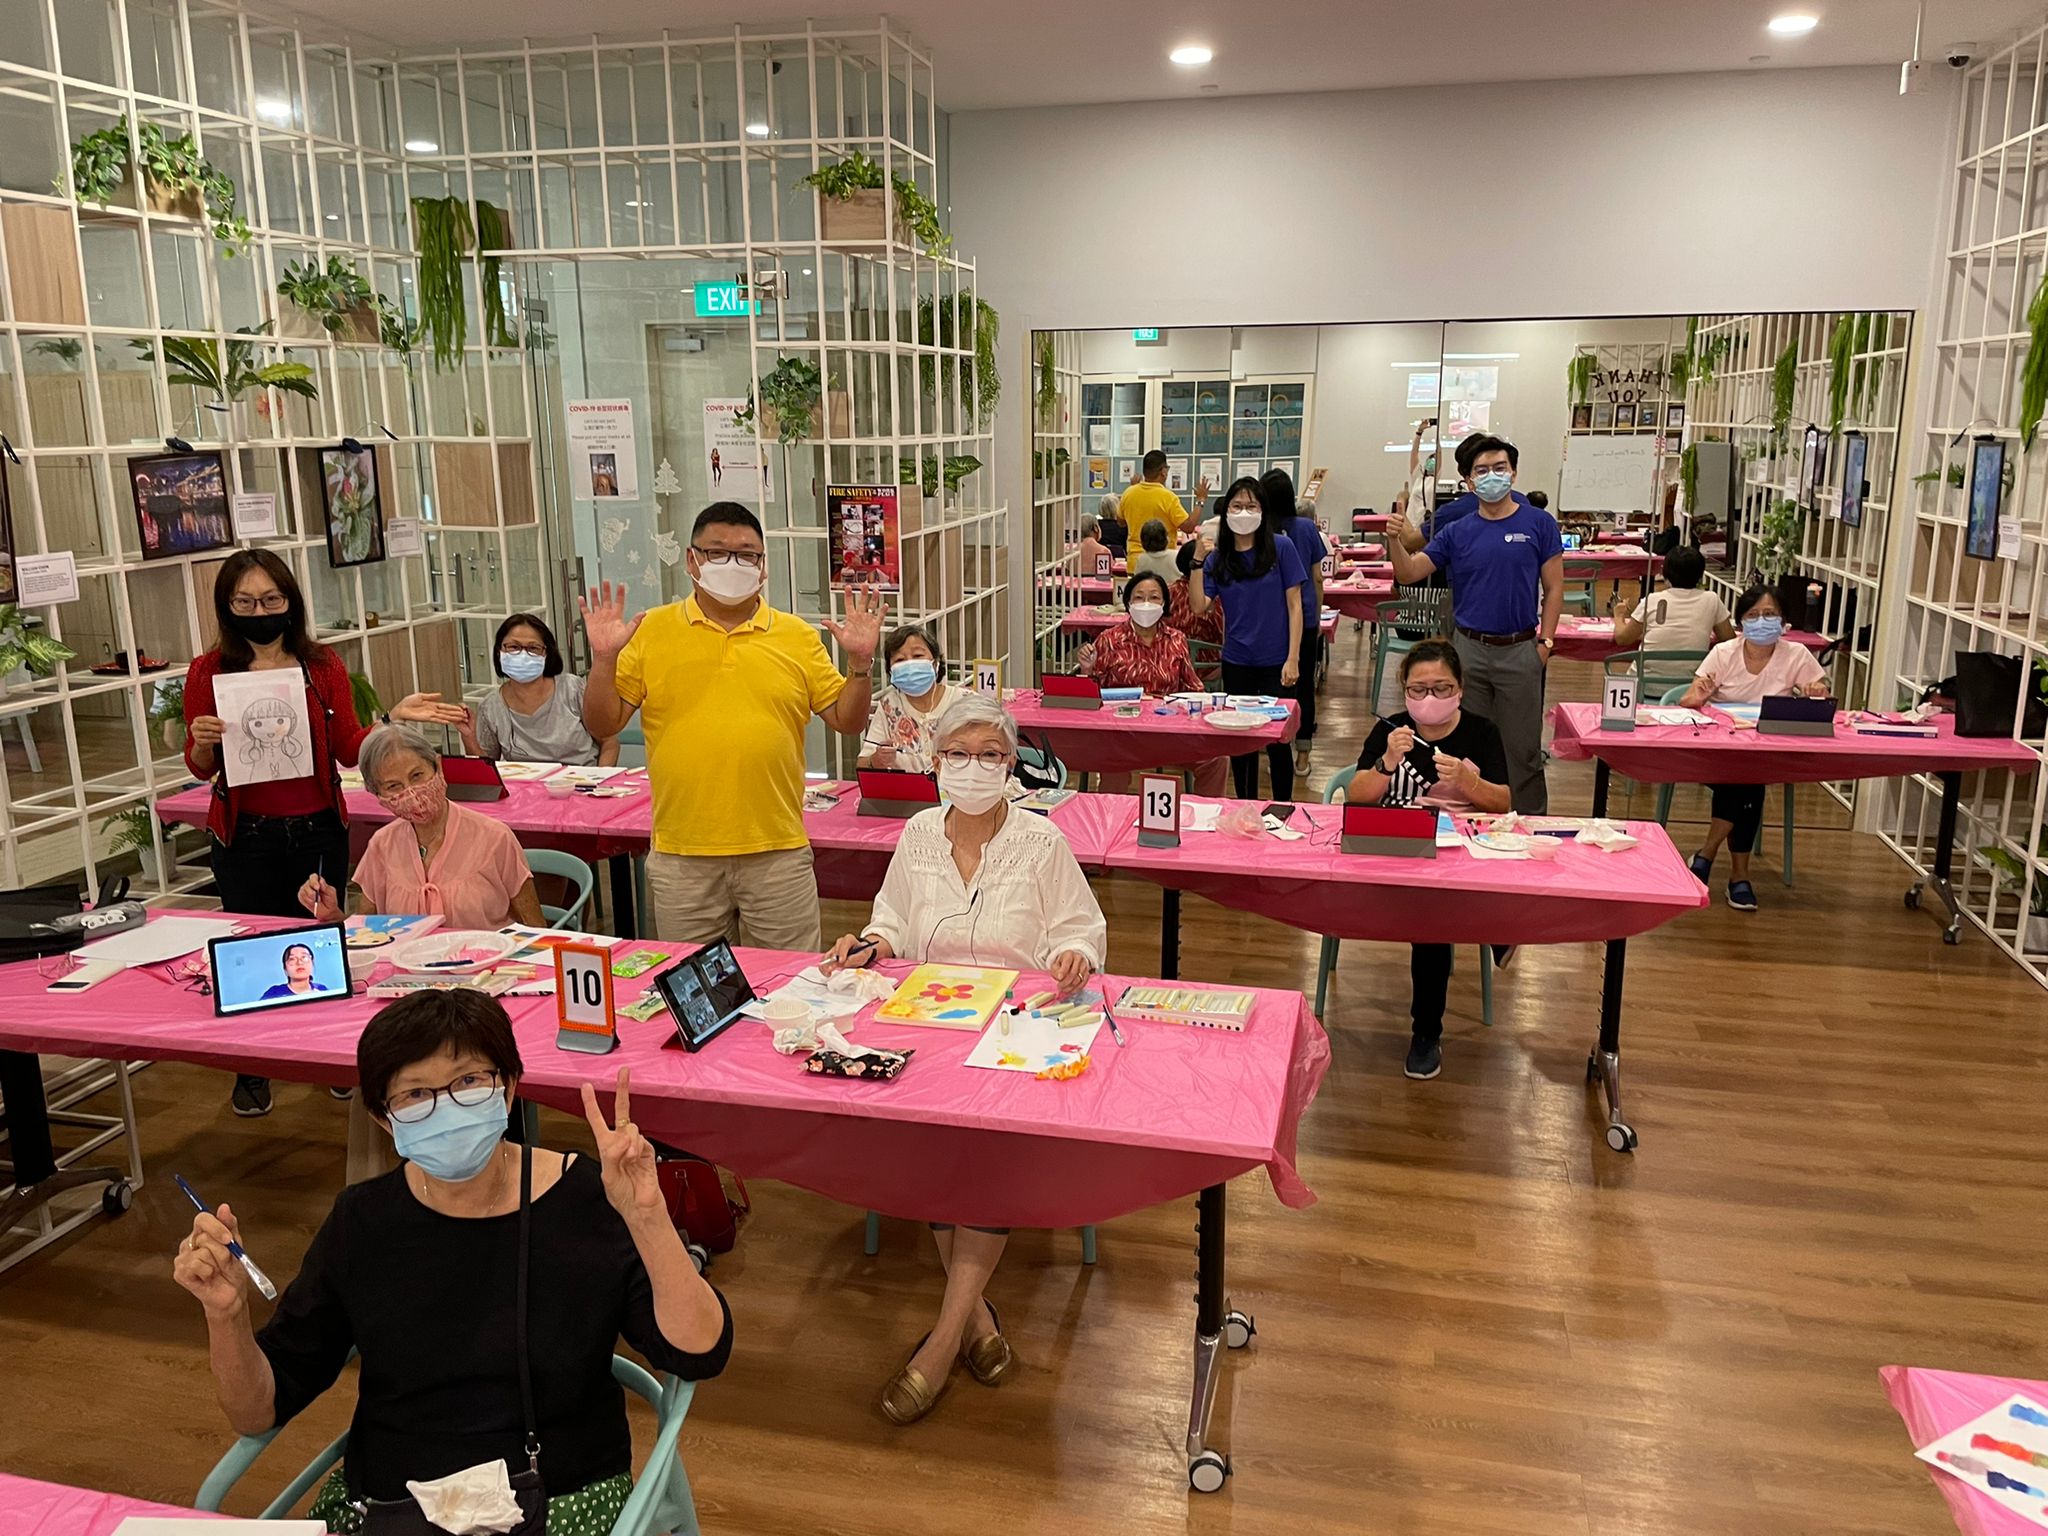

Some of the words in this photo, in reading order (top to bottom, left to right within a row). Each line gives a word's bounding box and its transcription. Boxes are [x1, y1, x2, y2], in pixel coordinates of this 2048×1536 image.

[706, 404, 733, 412] COVID-19
[829, 487, 846, 496] FIRE
[846, 487, 872, 496] SAFETY
[978, 671, 996, 690] 14
[1609, 688, 1631, 708] 15
[1147, 791, 1172, 818] 13
[566, 967, 602, 1007] 10
